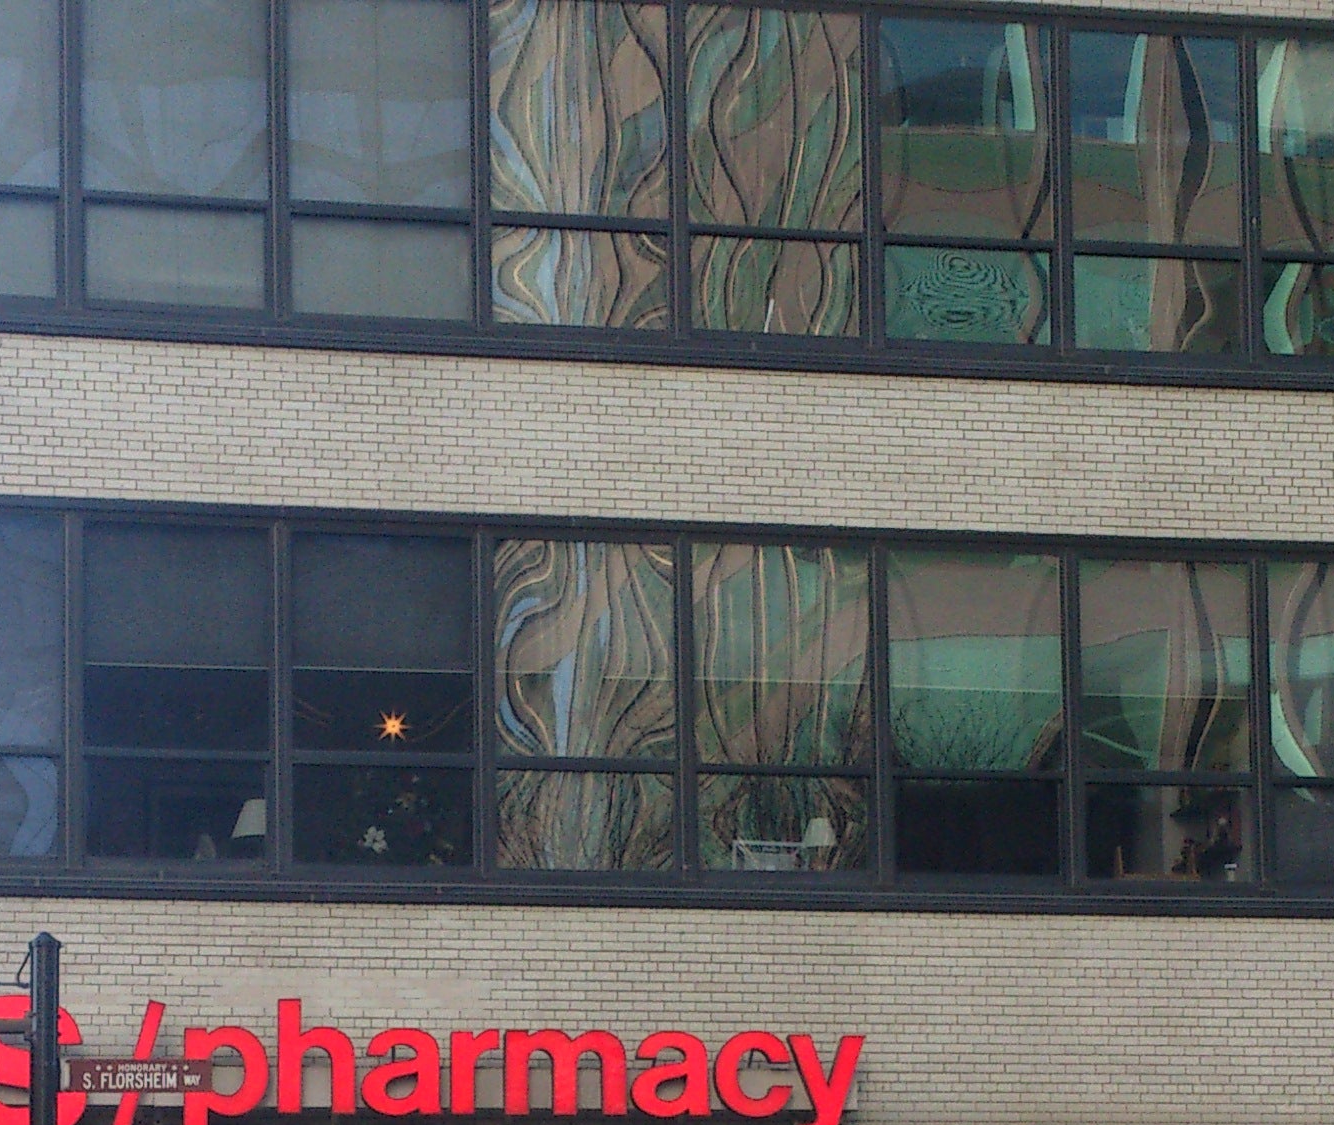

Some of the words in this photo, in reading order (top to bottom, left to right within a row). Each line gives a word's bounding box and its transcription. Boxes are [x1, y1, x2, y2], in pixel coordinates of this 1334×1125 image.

[118, 1063, 167, 1072] HONORARY
[82, 1072, 96, 1090] S.
[100, 1072, 178, 1090] FLORSHEIM
[183, 1074, 201, 1086] WAY
